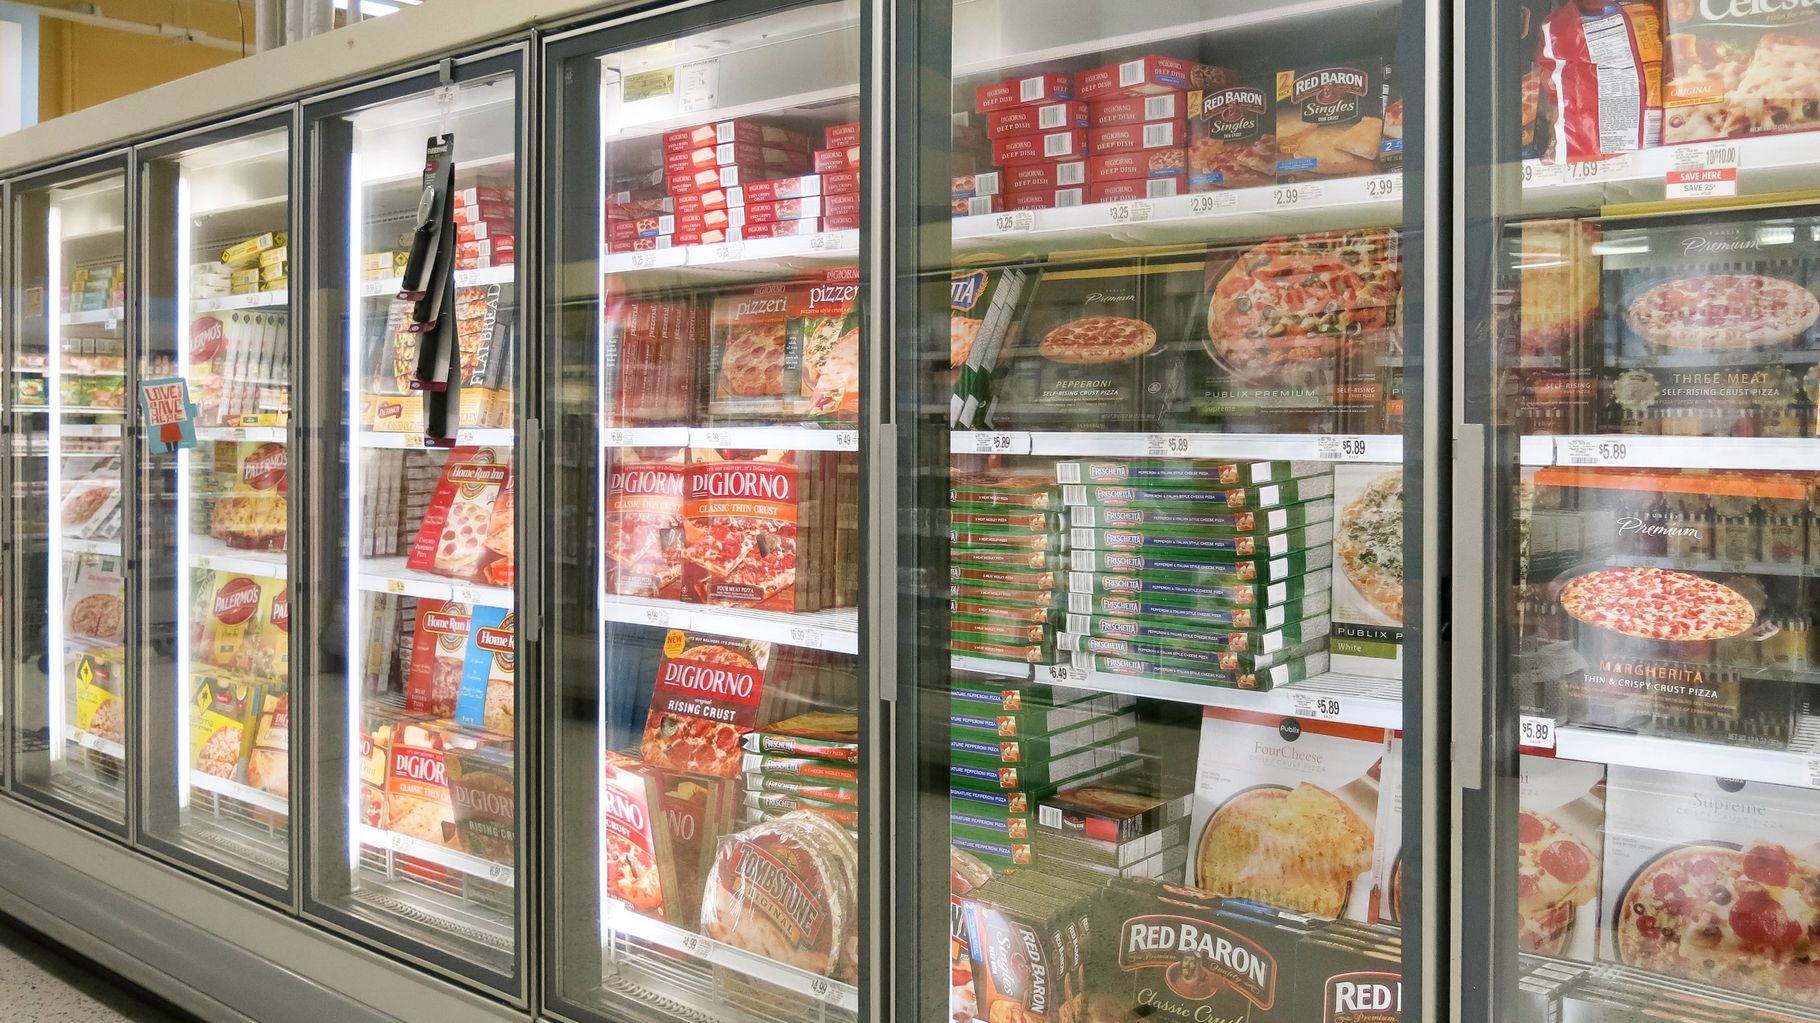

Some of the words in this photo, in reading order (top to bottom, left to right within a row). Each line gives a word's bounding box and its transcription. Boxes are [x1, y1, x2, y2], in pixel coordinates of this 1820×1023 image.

[1154, 68, 1170, 76] DEEP
[1171, 71, 1186, 79] DISH
[1082, 83, 1096, 92] DEEP
[1295, 76, 1319, 96] RED
[1320, 72, 1363, 88] BARON
[1670, 85, 1712, 97] ORIGINAL
[983, 98, 998, 106] DEEP
[1204, 95, 1224, 114] RED
[1226, 92, 1262, 106] BARON
[1304, 98, 1355, 117] Singles
[996, 124, 1013, 132] DEEP
[1099, 116, 1116, 124] DEEP
[1211, 117, 1255, 135] Singles
[1097, 142, 1116, 150] DEEP
[1386, 142, 1392, 152] 2
[1002, 151, 1018, 160] DEEP
[1100, 168, 1118, 176] DEEP
[1567, 161, 1597, 179] $7.69
[1680, 171, 1700, 182] SAVE
[1702, 170, 1722, 180] HERE
[1014, 180, 1030, 188] DEEP
[1367, 179, 1393, 196] $2.99
[1684, 184, 1702, 192] SAVE
[1191, 197, 1213, 212] $2.99
[1274, 189, 1298, 205] $2.99
[1110, 206, 1128, 220] $3.25
[996, 216, 1012, 230] $3.25
[1682, 236, 1760, 257] Premium
[827, 270, 859, 280] DIGIORN
[1085, 292, 1136, 304] Premium
[736, 296, 787, 320] pizzeri
[470, 283, 500, 386] FLATBREAD
[1056, 380, 1112, 388] PEPPERONI
[1546, 382, 1591, 390] SELF-RISING
[1674, 373, 1720, 384] THREE
[1728, 372, 1769, 384] MEAT
[145, 384, 177, 401] LOVE
[1256, 390, 1316, 398] PREMIUM
[1662, 388, 1716, 397] SELF-RISING
[1718, 388, 1750, 397] CRUST
[1753, 388, 1780, 397] PIZZA
[150, 399, 182, 416] SAVE
[994, 436, 1010, 449] $5.89
[1168, 438, 1188, 451] $5.89
[1343, 440, 1366, 456] $5.89
[1599, 444, 1626, 460] $5.89
[452, 468, 475, 479] Home
[476, 469, 492, 480] Run
[491, 470, 504, 480] Inn
[692, 471, 788, 500] DIGIORNO
[700, 504, 729, 513] CLASSIC
[731, 504, 752, 512] THIN
[754, 506, 778, 516] CRUST
[1616, 517, 1703, 540] Premium
[215, 586, 259, 612] PALERMO'S
[428, 615, 449, 629] Home
[450, 618, 465, 631] Run
[481, 630, 507, 647] Home
[668, 636, 682, 644] NEW
[1338, 628, 1388, 638] PUBLIX
[1338, 642, 1361, 652] White
[664, 662, 753, 698] DIGIORNO
[1049, 666, 1068, 680] $6.49
[1600, 660, 1704, 684] MARGHERITA
[1584, 674, 1606, 684] THIN
[1608, 678, 1615, 686] &
[1618, 678, 1651, 689] CRISPY
[1654, 682, 1685, 694] CRUST
[1689, 688, 1718, 699] PIZZA
[668, 700, 700, 715] RISING
[703, 706, 736, 721] CRUST
[1318, 699, 1340, 716] $5.89
[1280, 724, 1300, 735] Publix
[1522, 722, 1548, 740] $5.89
[396, 754, 448, 786] DIGIOR
[400, 783, 422, 794] CLASSIC
[1693, 792, 1766, 816] Supreme
[470, 820, 498, 838] RISING
[736, 845, 818, 936] TOMBSTONE
[742, 884, 794, 936] IGINAL
[996, 930, 1015, 996] Singles
[1129, 924, 1175, 953] RED
[1178, 924, 1266, 987] BARON
[1020, 928, 1040, 959] RED
[1032, 963, 1046, 1014] BARON
[812, 979, 828, 995] $4.99
[1137, 987, 1190, 1018] Classic
[1335, 981, 1392, 1014] RED
